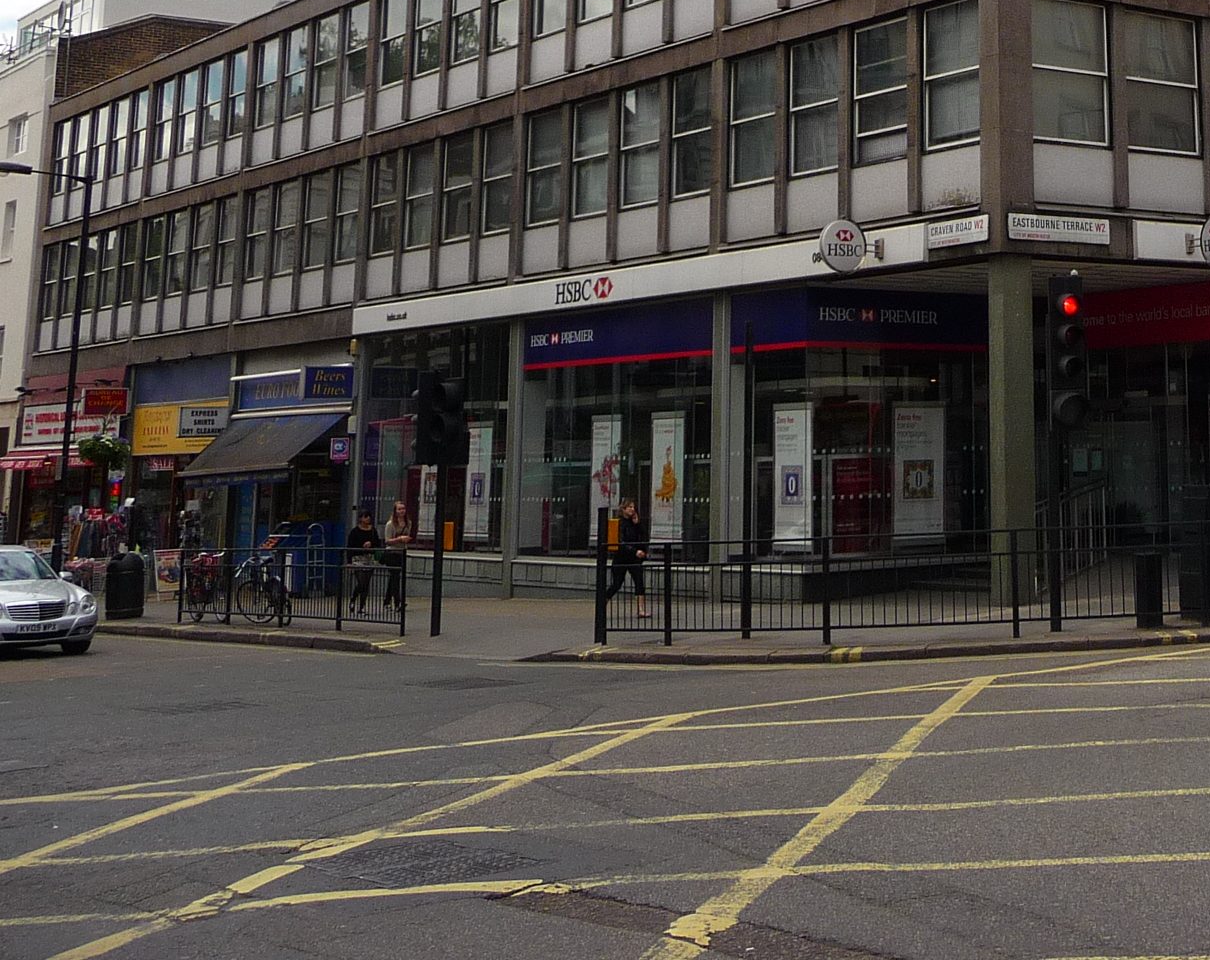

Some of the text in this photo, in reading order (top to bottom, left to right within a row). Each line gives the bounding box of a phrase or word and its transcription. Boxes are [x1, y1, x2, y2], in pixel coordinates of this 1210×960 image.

[931, 219, 984, 237] CRAVEN ROAD W2
[1012, 217, 1106, 233] EASTBOURNE TERRACE W2
[827, 243, 862, 258] HSBC
[555, 279, 592, 304] HSBC
[819, 306, 938, 324] HSBC PREMIER
[1107, 312, 1116, 325] to
[1118, 311, 1134, 324] the
[1135, 306, 1169, 322] world's
[1171, 303, 1193, 320] local
[530, 329, 594, 347] HSBC PREMIER
[315, 369, 346, 381] Beers
[255, 381, 300, 400] EURO FOO
[312, 383, 345, 396] Wines
[152, 459, 174, 470] SALE
[788, 476, 796, 494] 0
